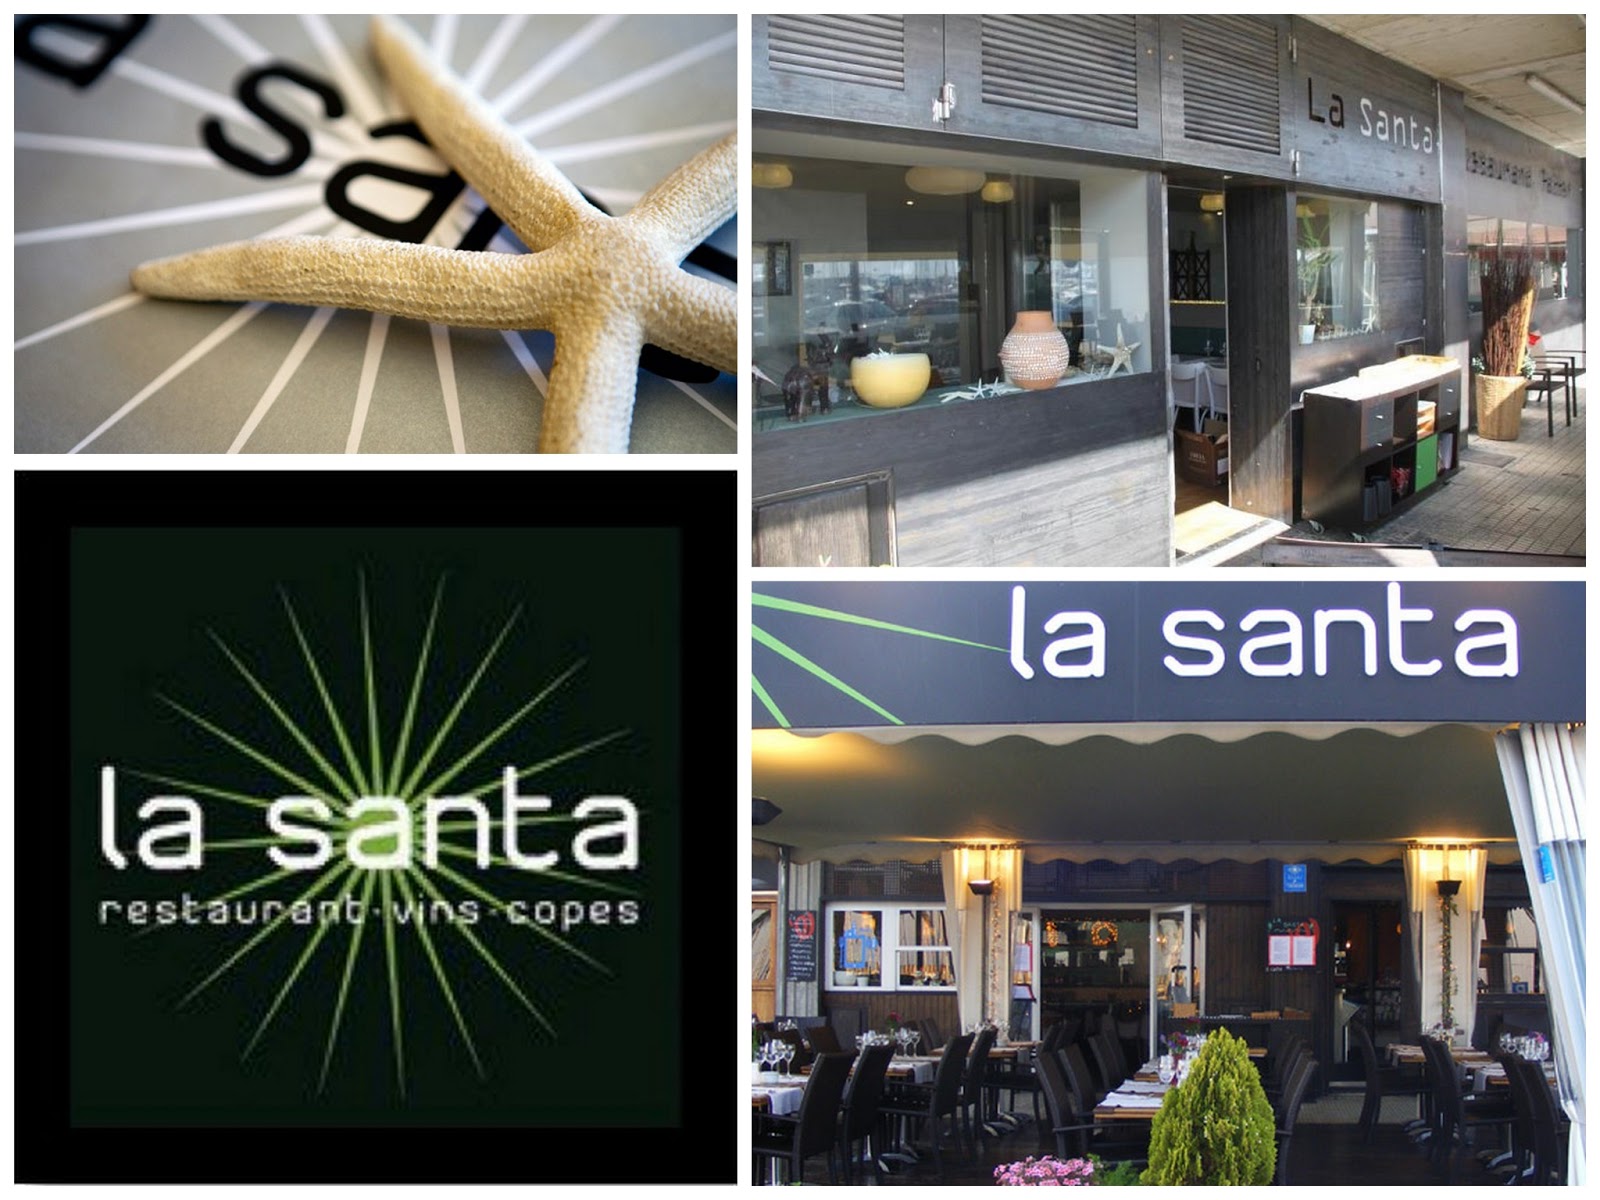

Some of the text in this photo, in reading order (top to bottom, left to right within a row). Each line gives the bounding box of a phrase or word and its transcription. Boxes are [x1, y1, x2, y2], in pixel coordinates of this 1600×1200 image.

[1307, 77, 1434, 154] La Santa
[1009, 582, 1520, 680] la santa
[100, 765, 640, 871] la santa
[100, 893, 640, 931] restaurant vins copes
